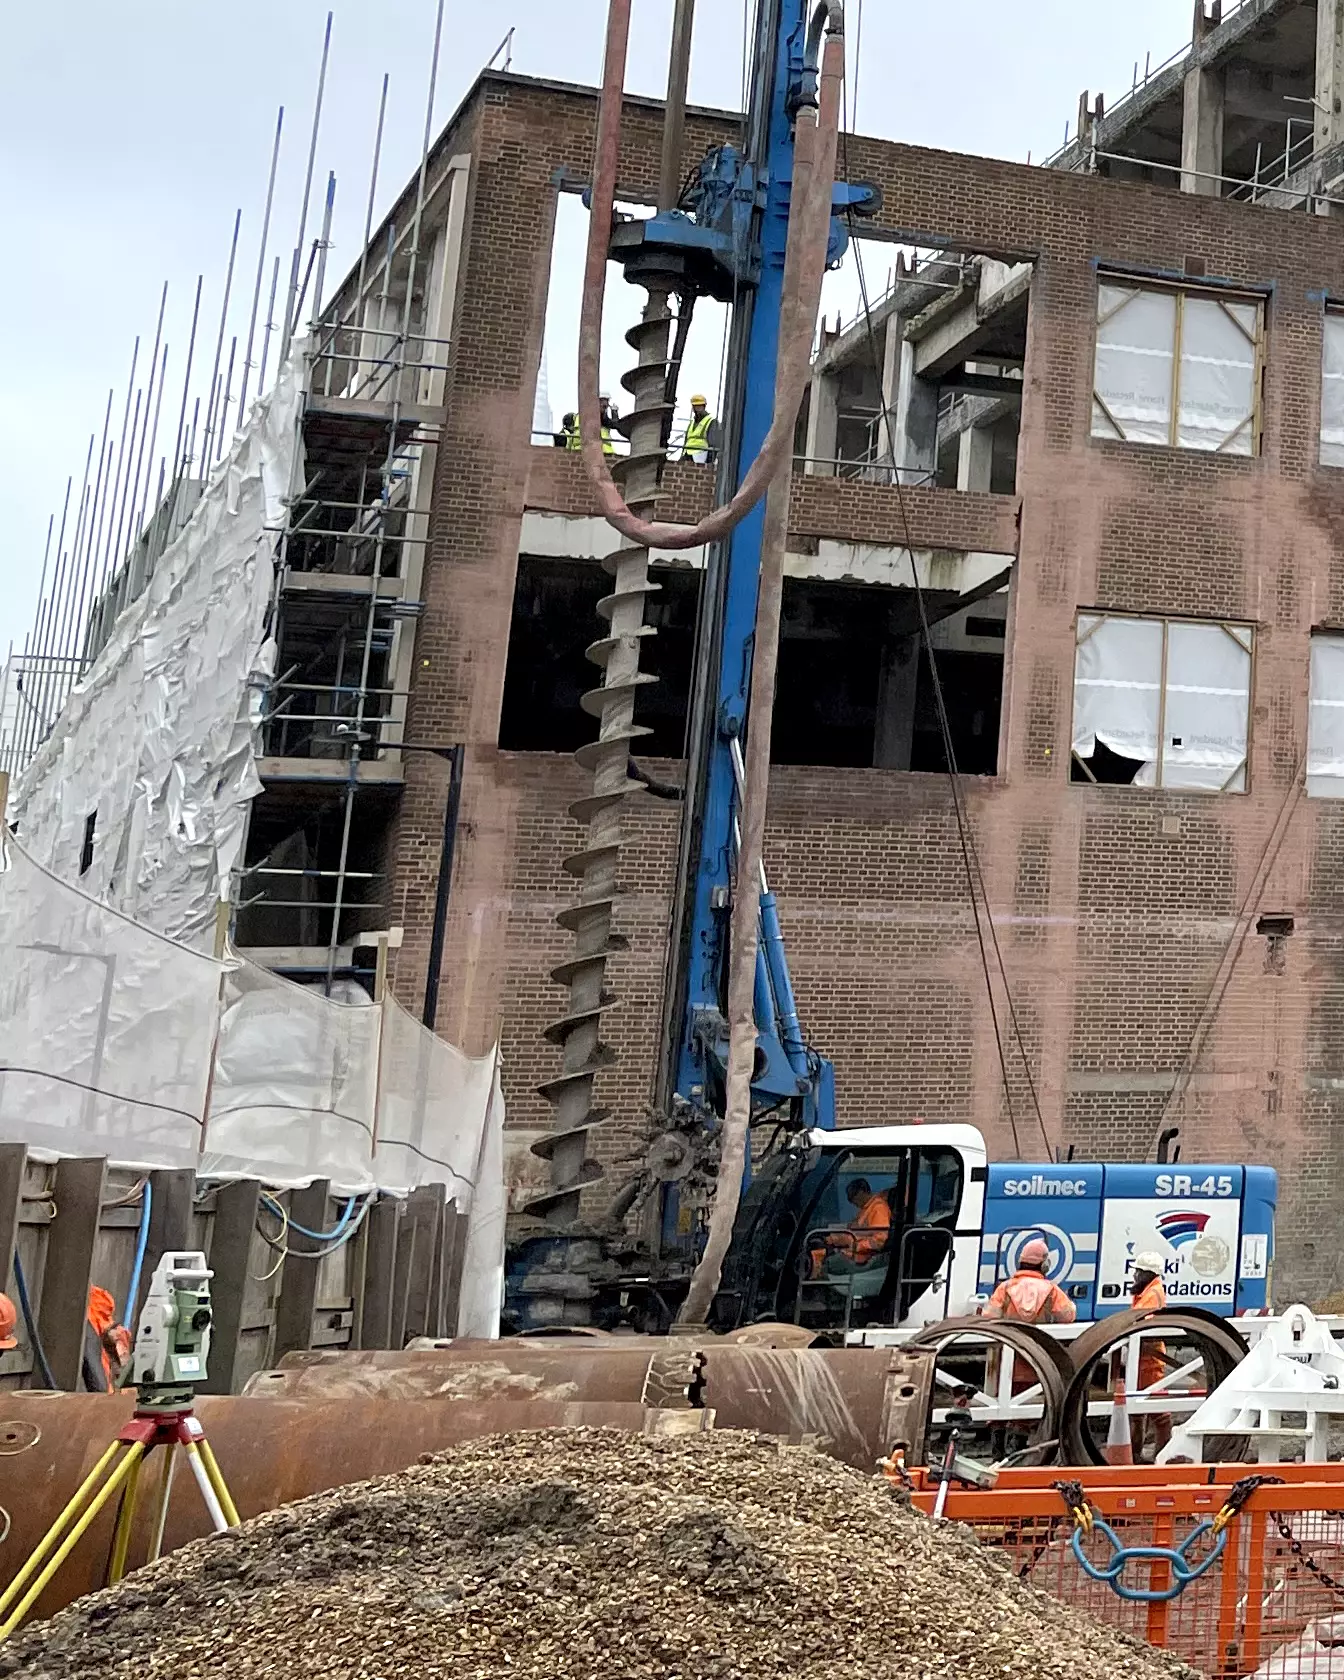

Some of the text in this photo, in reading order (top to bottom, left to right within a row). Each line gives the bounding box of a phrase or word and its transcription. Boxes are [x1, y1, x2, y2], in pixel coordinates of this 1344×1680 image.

[1003, 1175, 1087, 1196] soilmec
[1155, 1174, 1233, 1196] SR-45
[1124, 1258, 1180, 1274] Fki
[1123, 1280, 1232, 1297] Fdations
